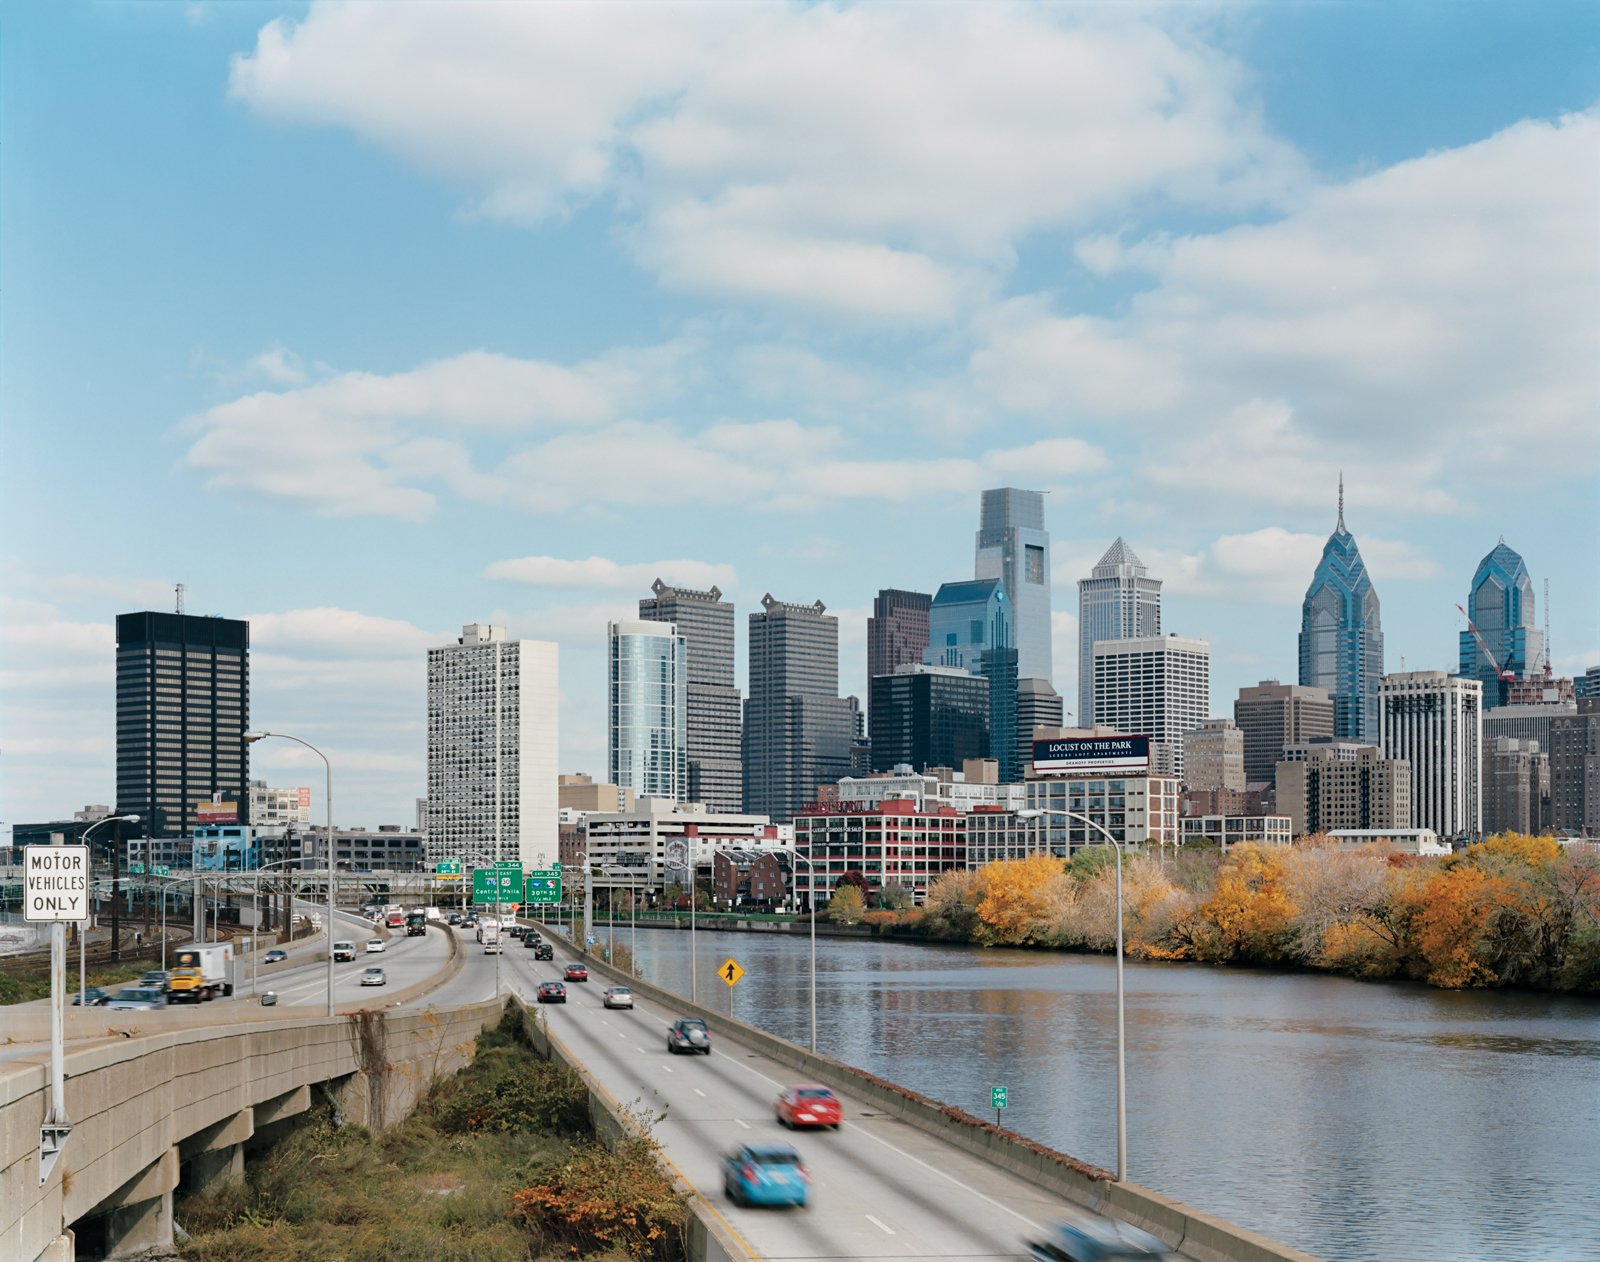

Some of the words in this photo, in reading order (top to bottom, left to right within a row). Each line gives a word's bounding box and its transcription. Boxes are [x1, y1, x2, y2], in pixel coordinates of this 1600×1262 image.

[1049, 743, 1079, 752] LOCUST
[1080, 742, 1093, 751] ON
[1094, 741, 1110, 750] THE
[1111, 740, 1132, 750] PARK
[32, 856, 81, 870] MOTOR
[29, 876, 85, 890] VEHICLES
[33, 896, 79, 911] ONLY
[993, 1092, 1006, 1100] 345
